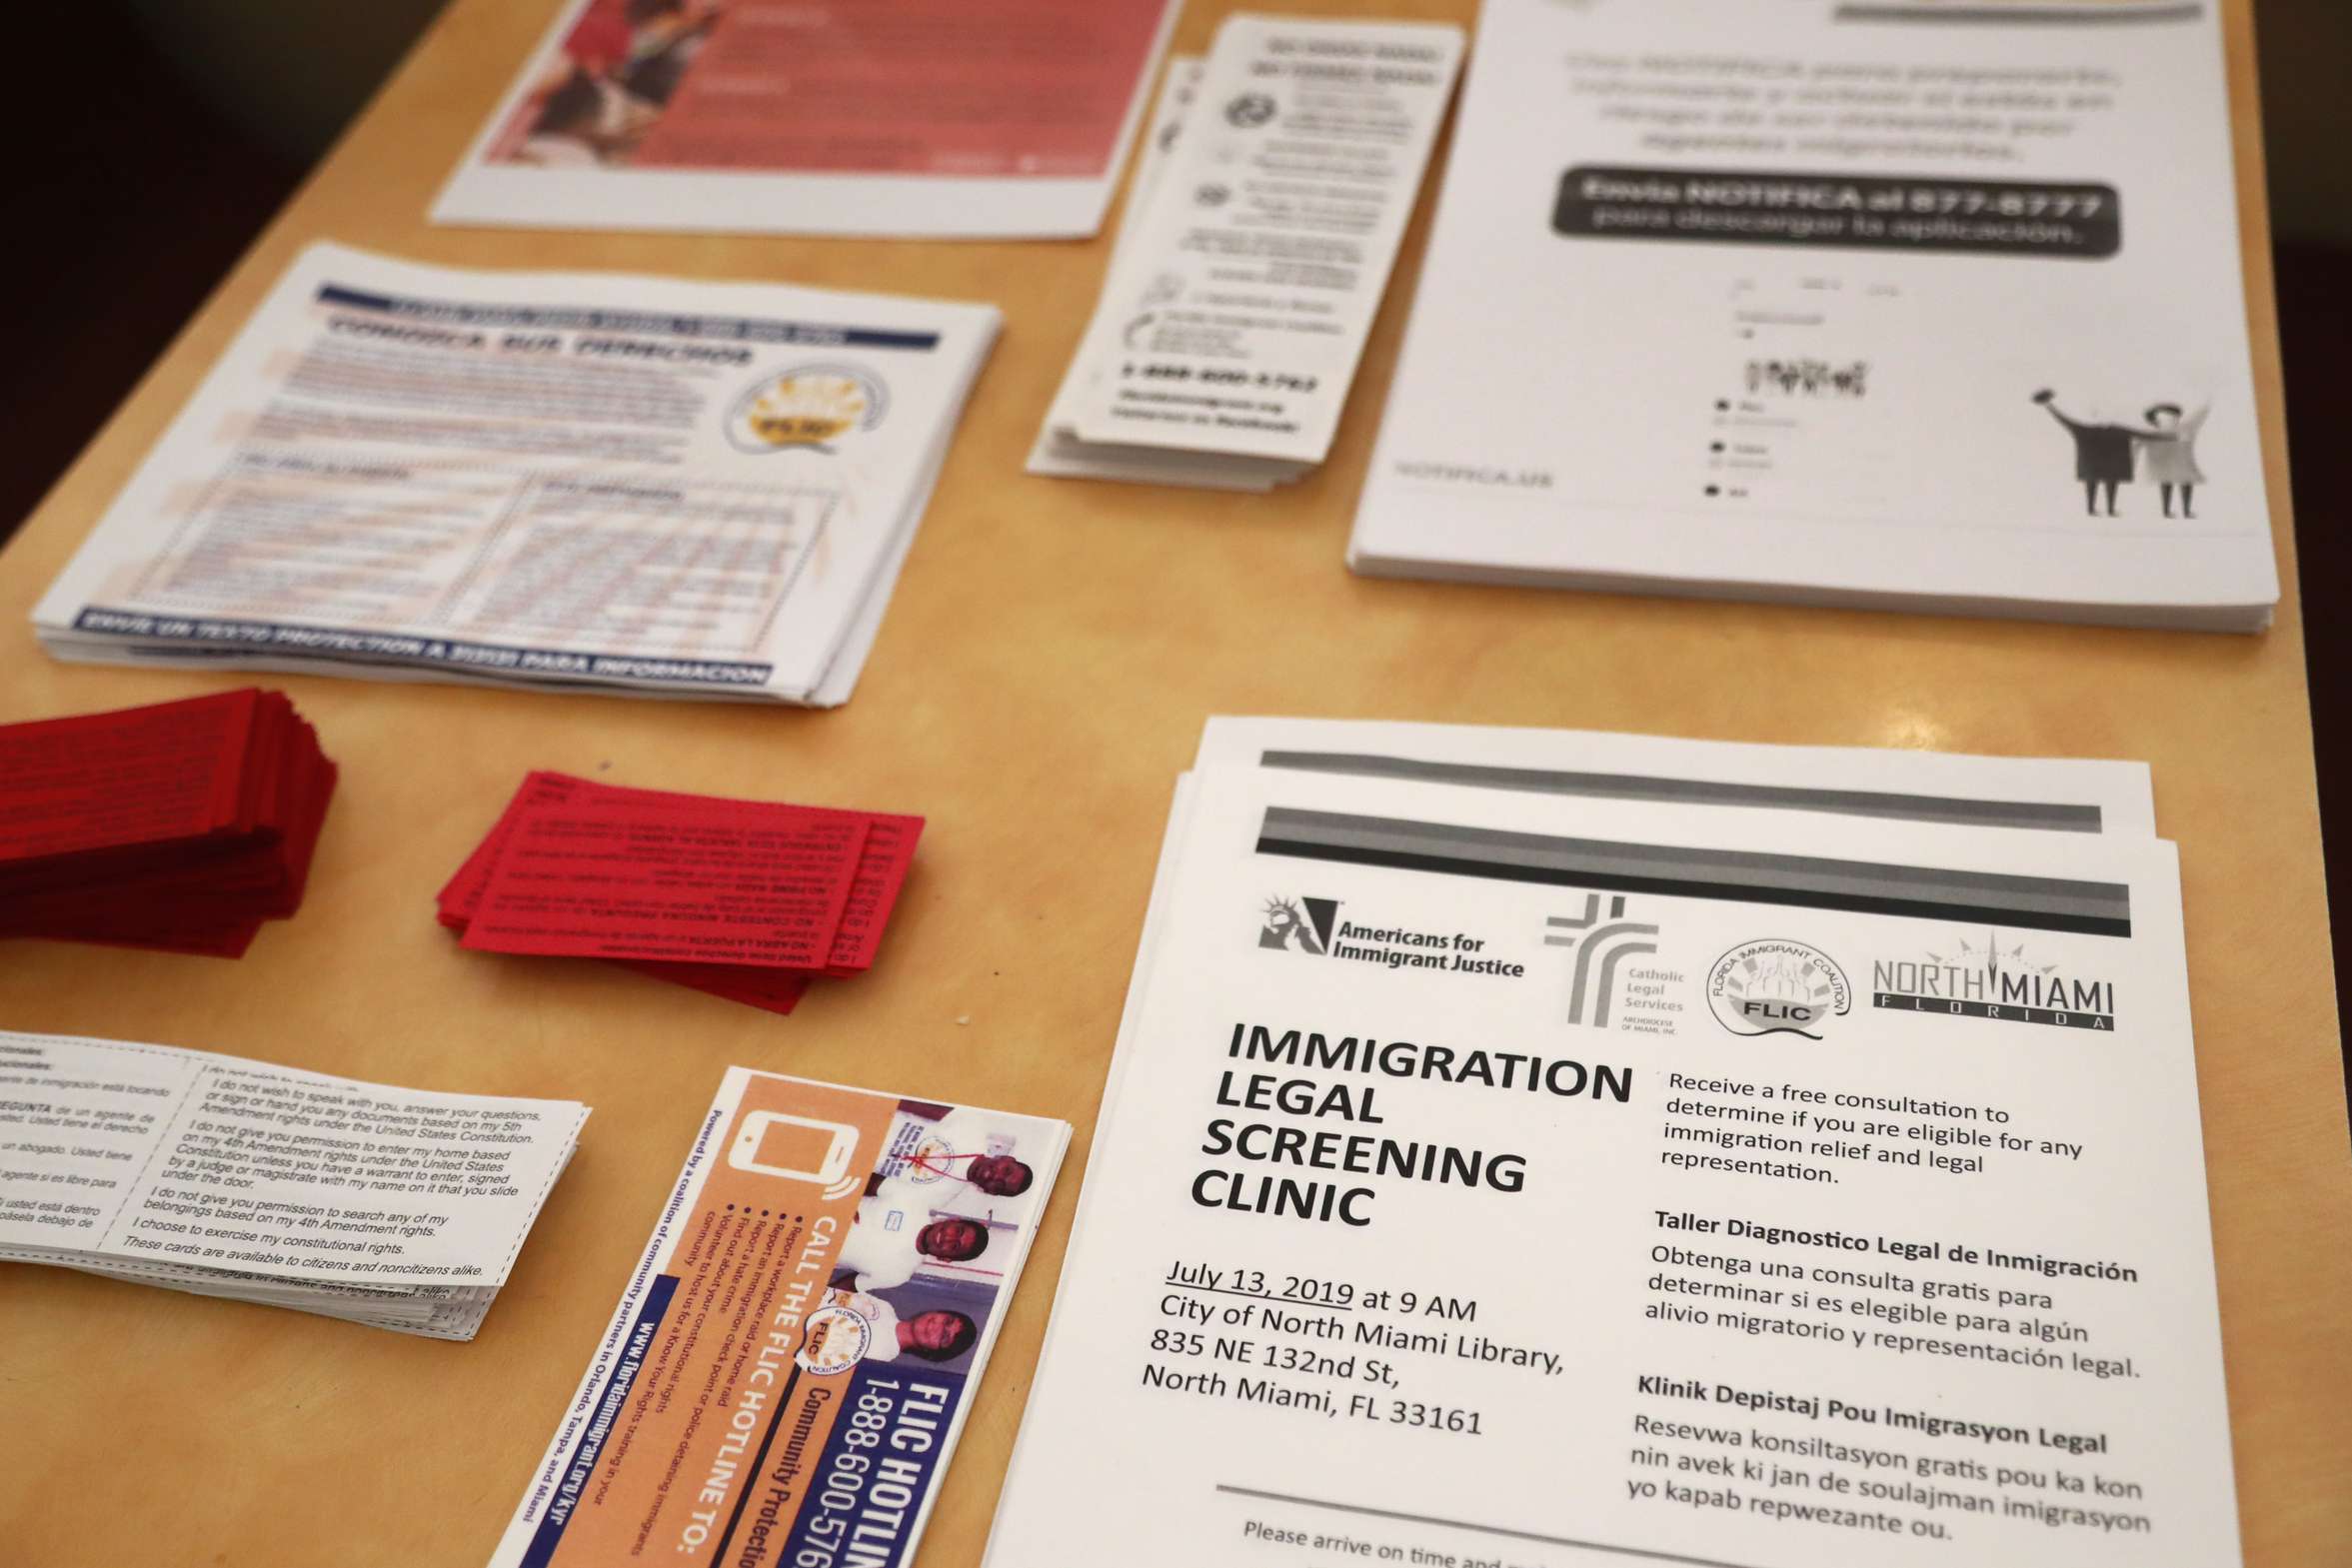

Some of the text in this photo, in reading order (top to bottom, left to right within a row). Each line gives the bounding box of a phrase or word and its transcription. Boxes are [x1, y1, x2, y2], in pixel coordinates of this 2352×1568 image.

[1332, 940, 1525, 978] Immigrant Justice
[1336, 920, 1485, 953] Americans for
[1627, 982, 1664, 996] Legal
[1629, 968, 1684, 982] Catholic
[1712, 944, 1845, 1009] FLORIDA IMMIGRANT COALITION
[1873, 959, 2114, 1015] NORTH MIAMI
[1624, 997, 1683, 1011] Services
[1743, 1001, 1811, 1021] FLIC
[1879, 994, 2107, 1030] FLORIDA
[1227, 1022, 1633, 1104] IMMIGRATION
[1215, 1069, 1384, 1125] LEGAL
[1669, 1072, 2010, 1124] Receive a free consultation to
[694, 1109, 723, 1153] Powered
[1663, 1121, 1983, 1175] immigration relief and legal
[1665, 1096, 2083, 1161] determine if you are eligible for any
[687, 1154, 703, 1168] by
[1200, 1118, 1527, 1193] SCREENING
[1660, 1151, 1839, 1184] representation.
[662, 1177, 692, 1224] coalition
[1190, 1168, 1376, 1227] CLINIC
[123, 1235, 484, 1276] These cards are available to citizens and noncitizens alike.
[133, 1217, 405, 1255] I choose to exercise my constitutional rights.
[656, 1225, 670, 1237] of
[778, 1225, 803, 1259] Report
[1654, 1209, 2138, 1283] Taller Diagnostico Legal de Inmigración
[625, 1238, 664, 1300] community
[752, 1268, 785, 1318] workplace
[1166, 1260, 1477, 1322] July 13, 2019 at 9 AM
[1650, 1244, 2053, 1310] Obtenga una consulta gratis para
[602, 1300, 635, 1349] partners
[744, 1320, 763, 1339] raid
[1647, 1272, 2089, 1344] determinar si es elegible para algún
[599, 1350, 613, 1362] in
[739, 1341, 751, 1352] or
[806, 1321, 830, 1355] FLIC
[1150, 1328, 1399, 1390] 835 NE 132nd St,
[1160, 1293, 1563, 1376] City of North Miami Library,
[1644, 1300, 2141, 1380] alivio migratorio y representación legal.
[574, 1363, 607, 1413] Orlando,
[674, 1214, 841, 1555] CALL THE FLIC HOTLINE TO:
[726, 1354, 748, 1384] home
[716, 1386, 735, 1407] raid
[886, 1382, 952, 1454] FLIC
[1142, 1363, 1482, 1436] North Miami, FL 33161
[1637, 1374, 2107, 1456] Klinik Depistaj Pou Imigrasyon Legal
[545, 1320, 656, 1526] www.floridaimmigrant.org/kyr
[552, 1414, 583, 1457] Tampa,
[770, 1385, 833, 1485] Community
[541, 1458, 561, 1482] and
[521, 1484, 549, 1523] Miami
